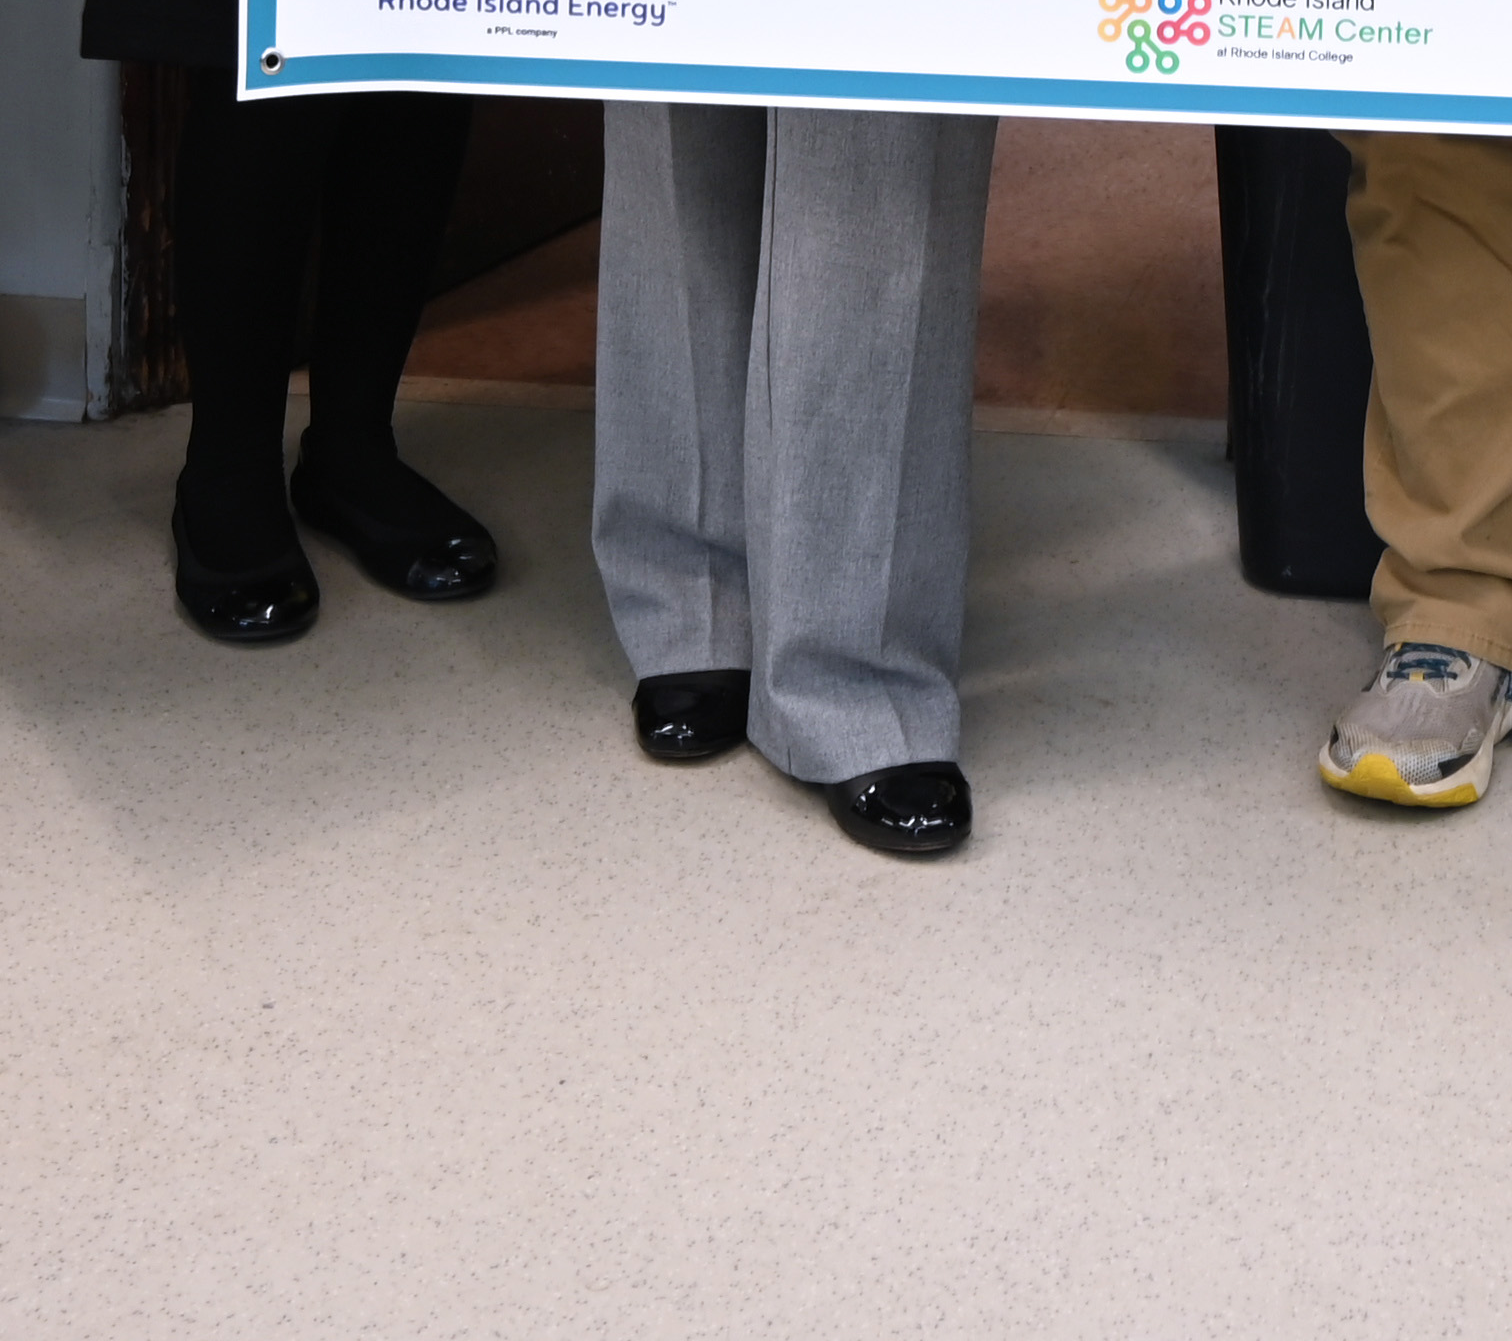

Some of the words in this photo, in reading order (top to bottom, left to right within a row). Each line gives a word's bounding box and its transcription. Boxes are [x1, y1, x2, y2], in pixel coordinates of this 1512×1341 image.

[494, 26, 513, 35] PPL
[516, 28, 558, 38] company
[1217, 14, 1324, 41] STEAM
[1335, 18, 1434, 46] Center
[1217, 47, 1228, 58] at
[1231, 47, 1268, 60] Rhode
[1272, 49, 1305, 61] Island
[1308, 50, 1354, 64] College
